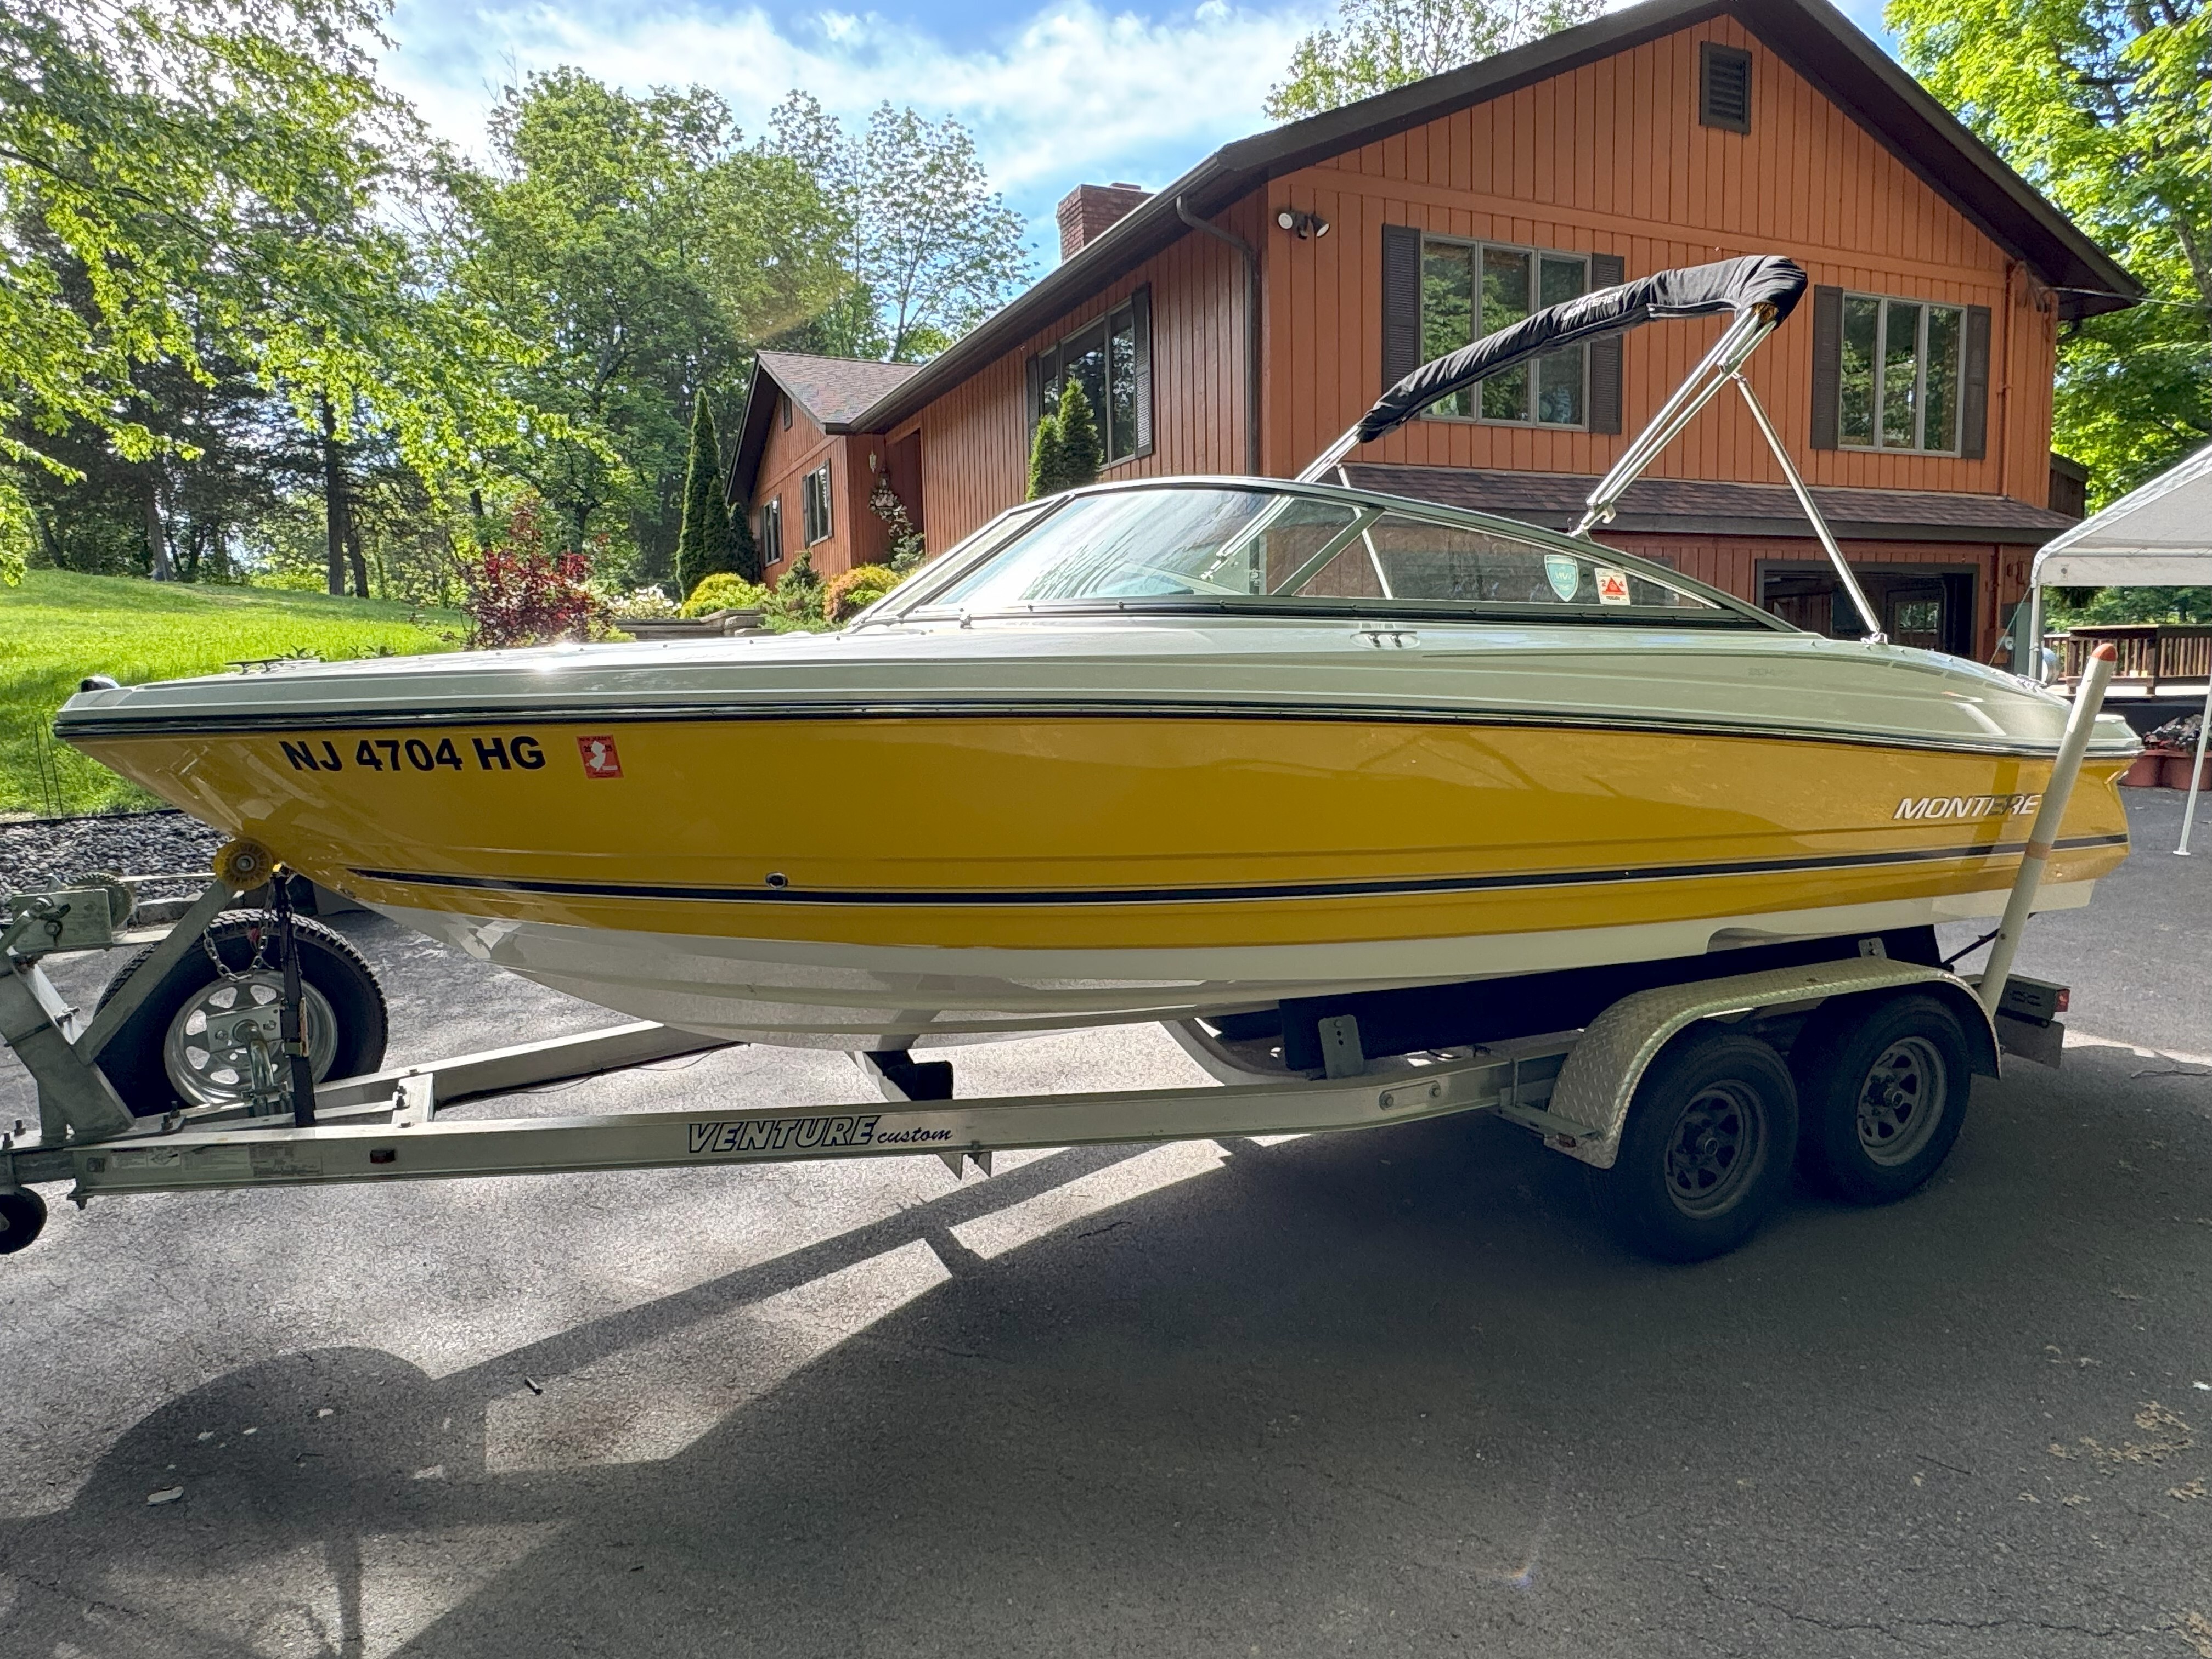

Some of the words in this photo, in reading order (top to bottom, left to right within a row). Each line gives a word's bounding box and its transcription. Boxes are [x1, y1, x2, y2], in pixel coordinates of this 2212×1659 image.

[279, 741, 341, 771] NJ
[356, 738, 462, 771] 4704
[472, 736, 546, 770] HG
[1893, 793, 2042, 820] MONTERE
[689, 1115, 881, 1153] VENTURE
[877, 1127, 952, 1143] custom
